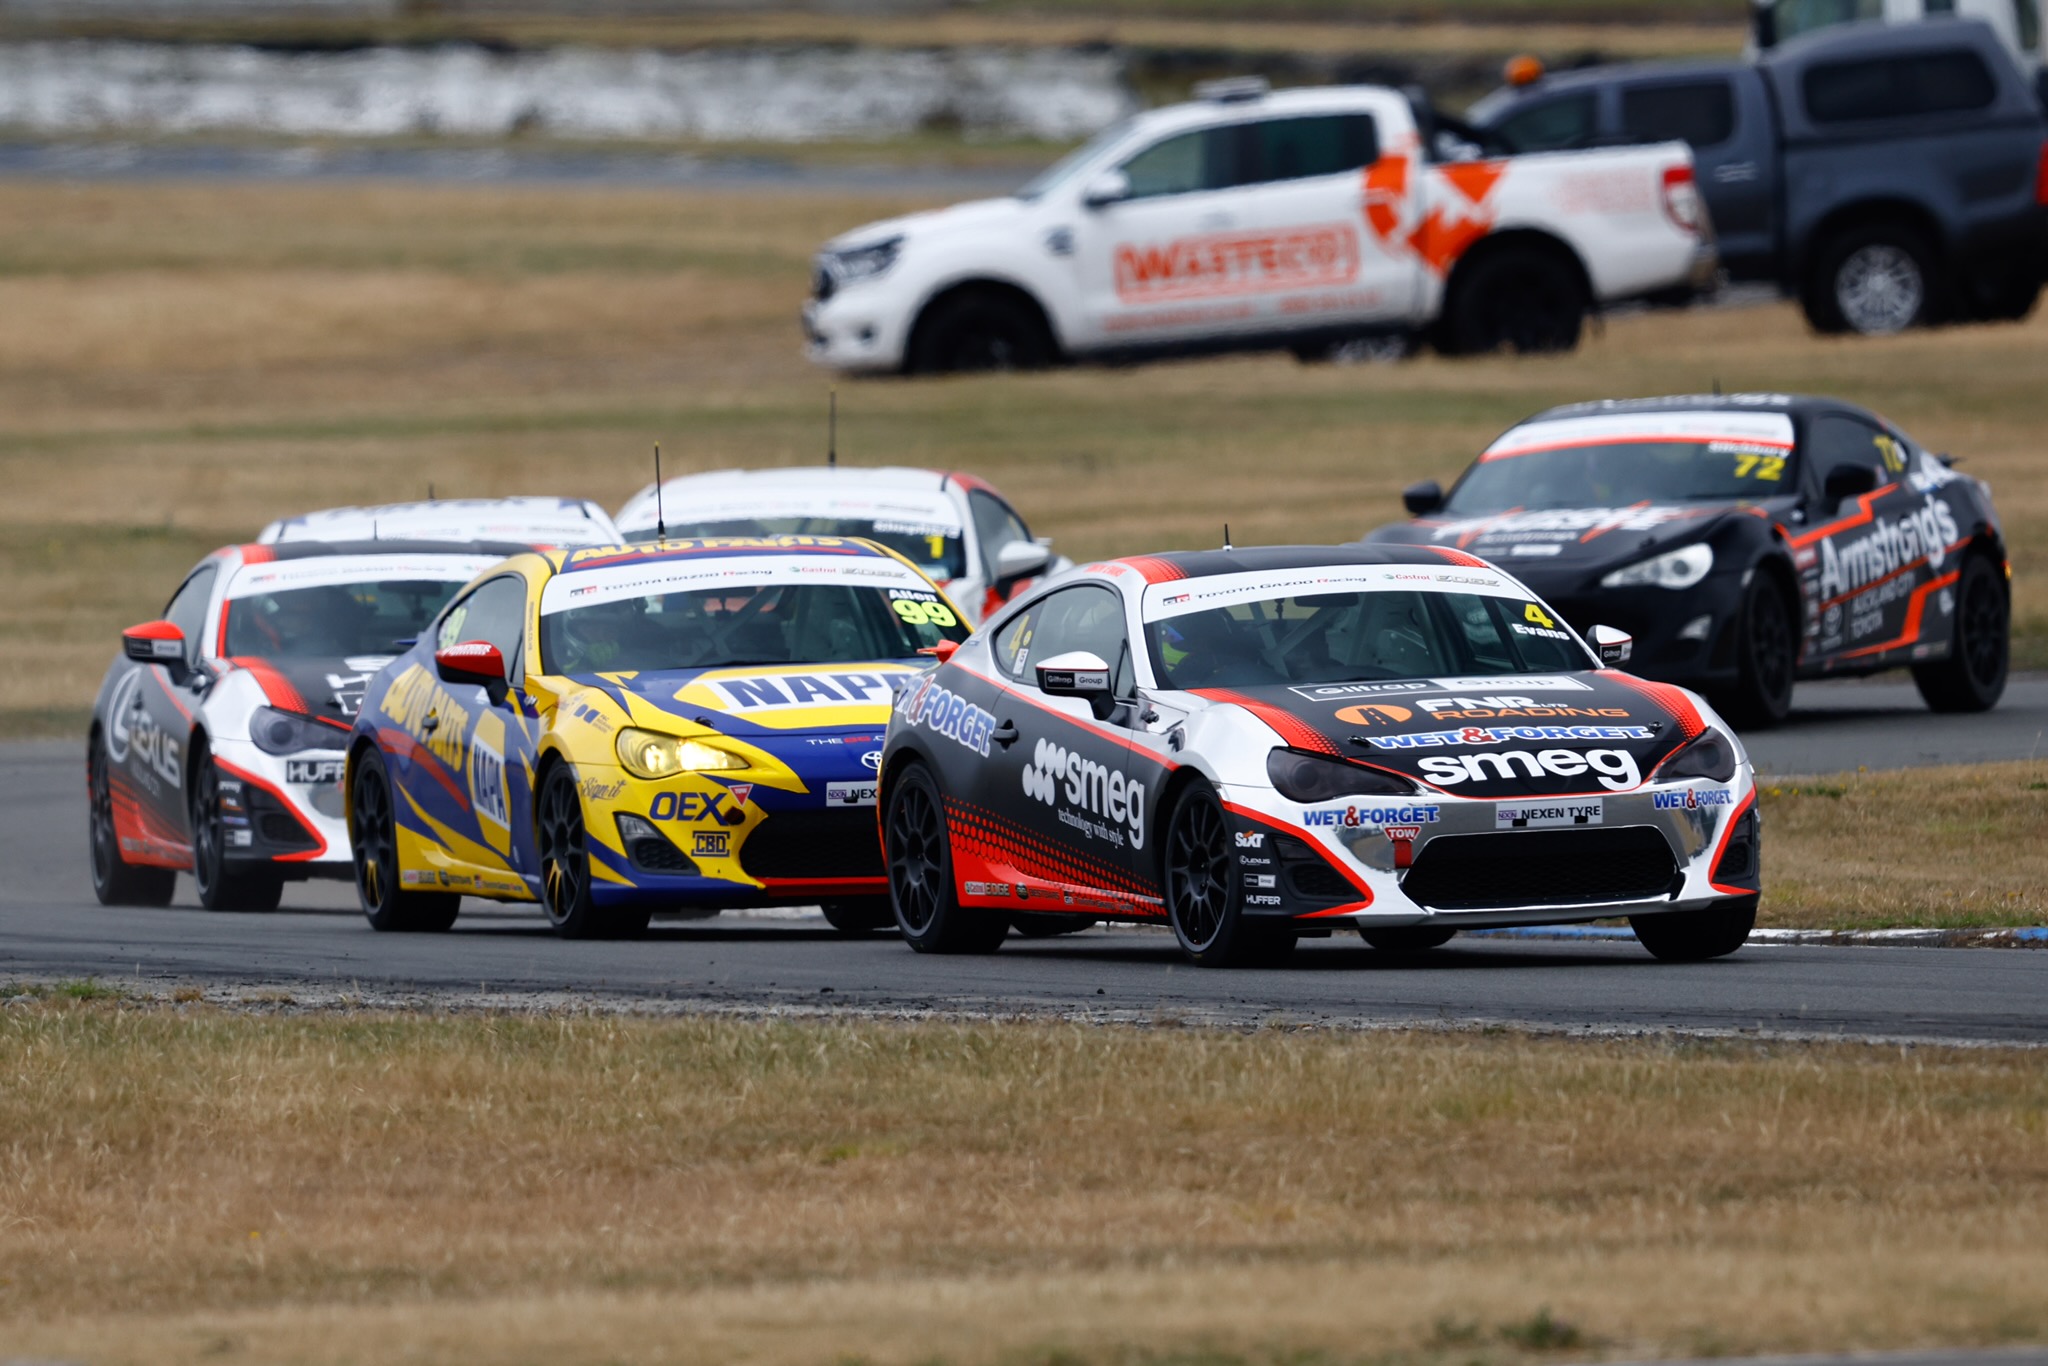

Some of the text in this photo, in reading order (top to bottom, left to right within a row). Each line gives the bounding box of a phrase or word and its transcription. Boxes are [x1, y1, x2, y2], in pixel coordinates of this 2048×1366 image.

[1734, 454, 1785, 480] 72
[925, 535, 944, 559] 1
[889, 589, 938, 602] Allen
[1195, 586, 1255, 599] TOYOTA
[1260, 579, 1313, 589] GAZOO
[1317, 576, 1367, 584] Racing
[892, 600, 957, 627] 99
[1524, 603, 1555, 629] 4
[1512, 623, 1571, 641] Evans
[1079, 676, 1103, 685] Group
[1315, 678, 1555, 694] Giltrap Group
[1416, 696, 1540, 711] FNR
[1431, 708, 1630, 721] ROADING
[1418, 749, 1642, 791] smeg
[649, 792, 730, 826] OEX
[1065, 752, 1145, 850] smeg
[1522, 808, 1564, 819] NEXEN
[1568, 806, 1601, 817] TYRE
[1058, 808, 1092, 838] technology
[1388, 829, 1415, 838] TOW
[696, 835, 726, 853] CBD
[985, 883, 1010, 896] EDGE
[1246, 894, 1281, 905] HUFFER
